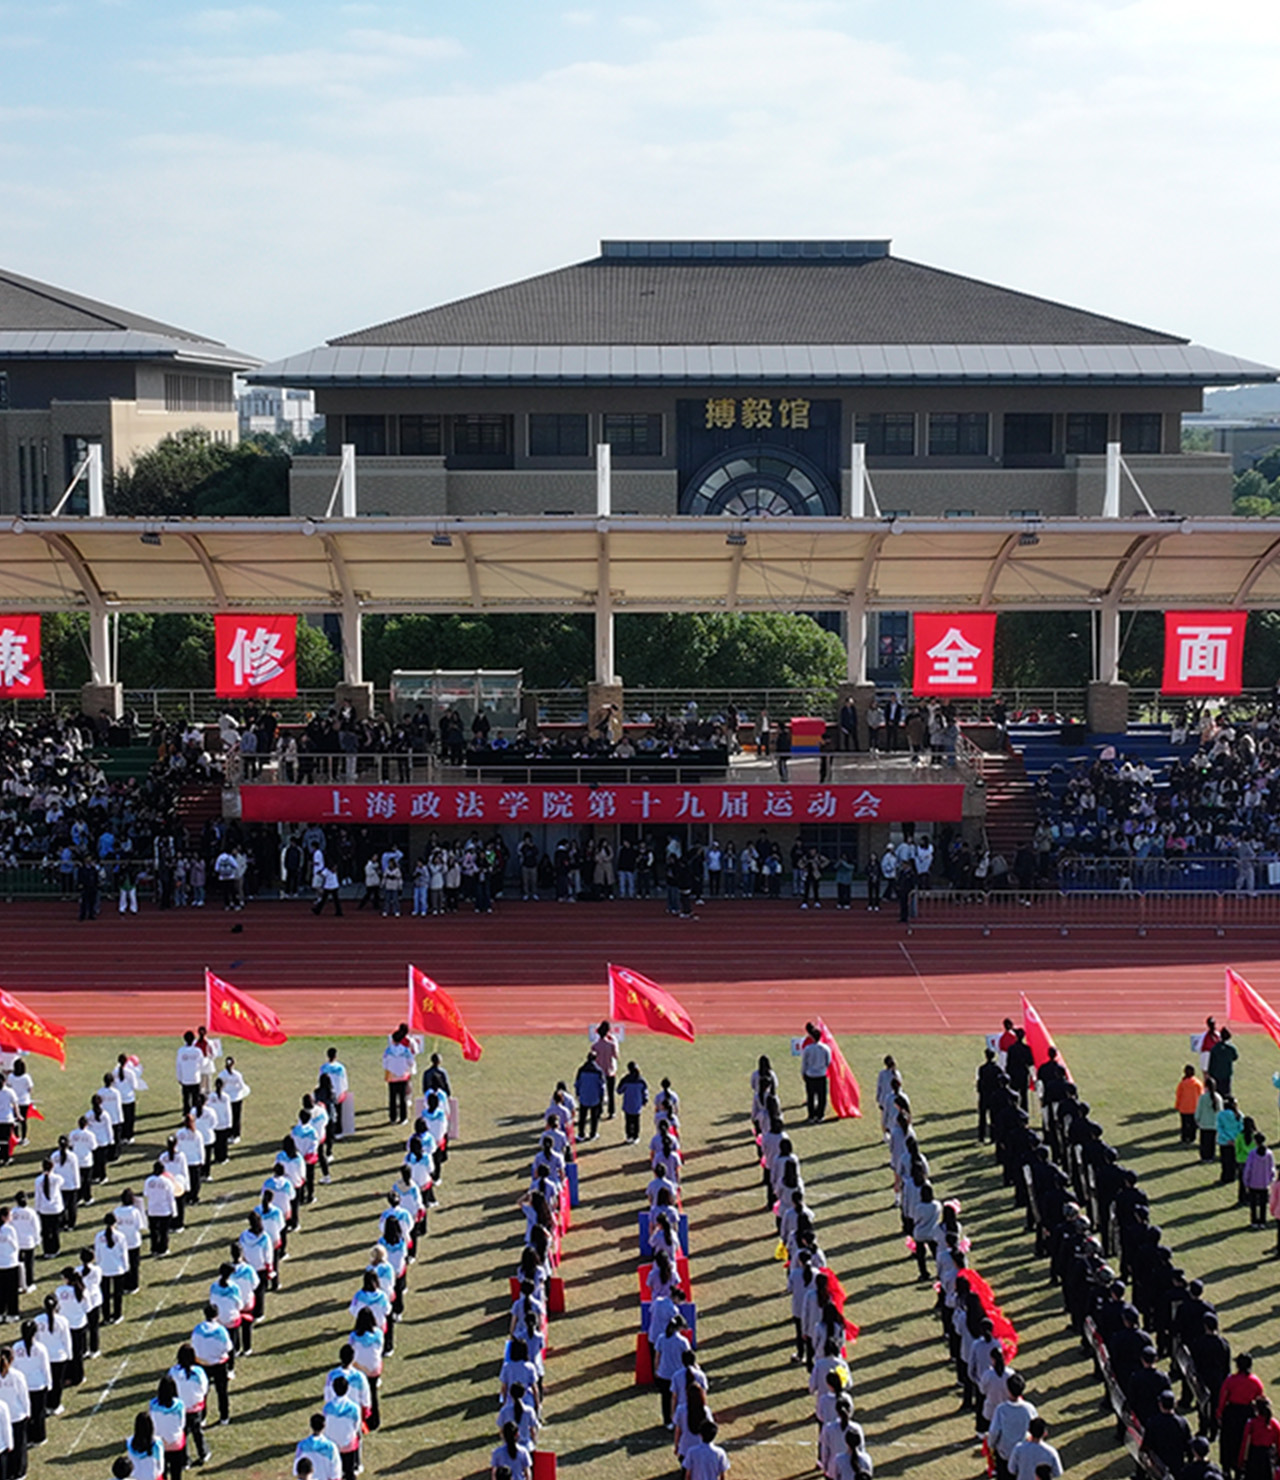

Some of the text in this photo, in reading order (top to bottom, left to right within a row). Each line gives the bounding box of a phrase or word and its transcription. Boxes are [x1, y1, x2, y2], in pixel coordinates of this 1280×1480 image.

[227, 627, 284, 686] 修
[926, 627, 982, 684] 全
[1176, 626, 1233, 682] 面
[322, 790, 882, 818] 上海政法学院第十九届运动会
